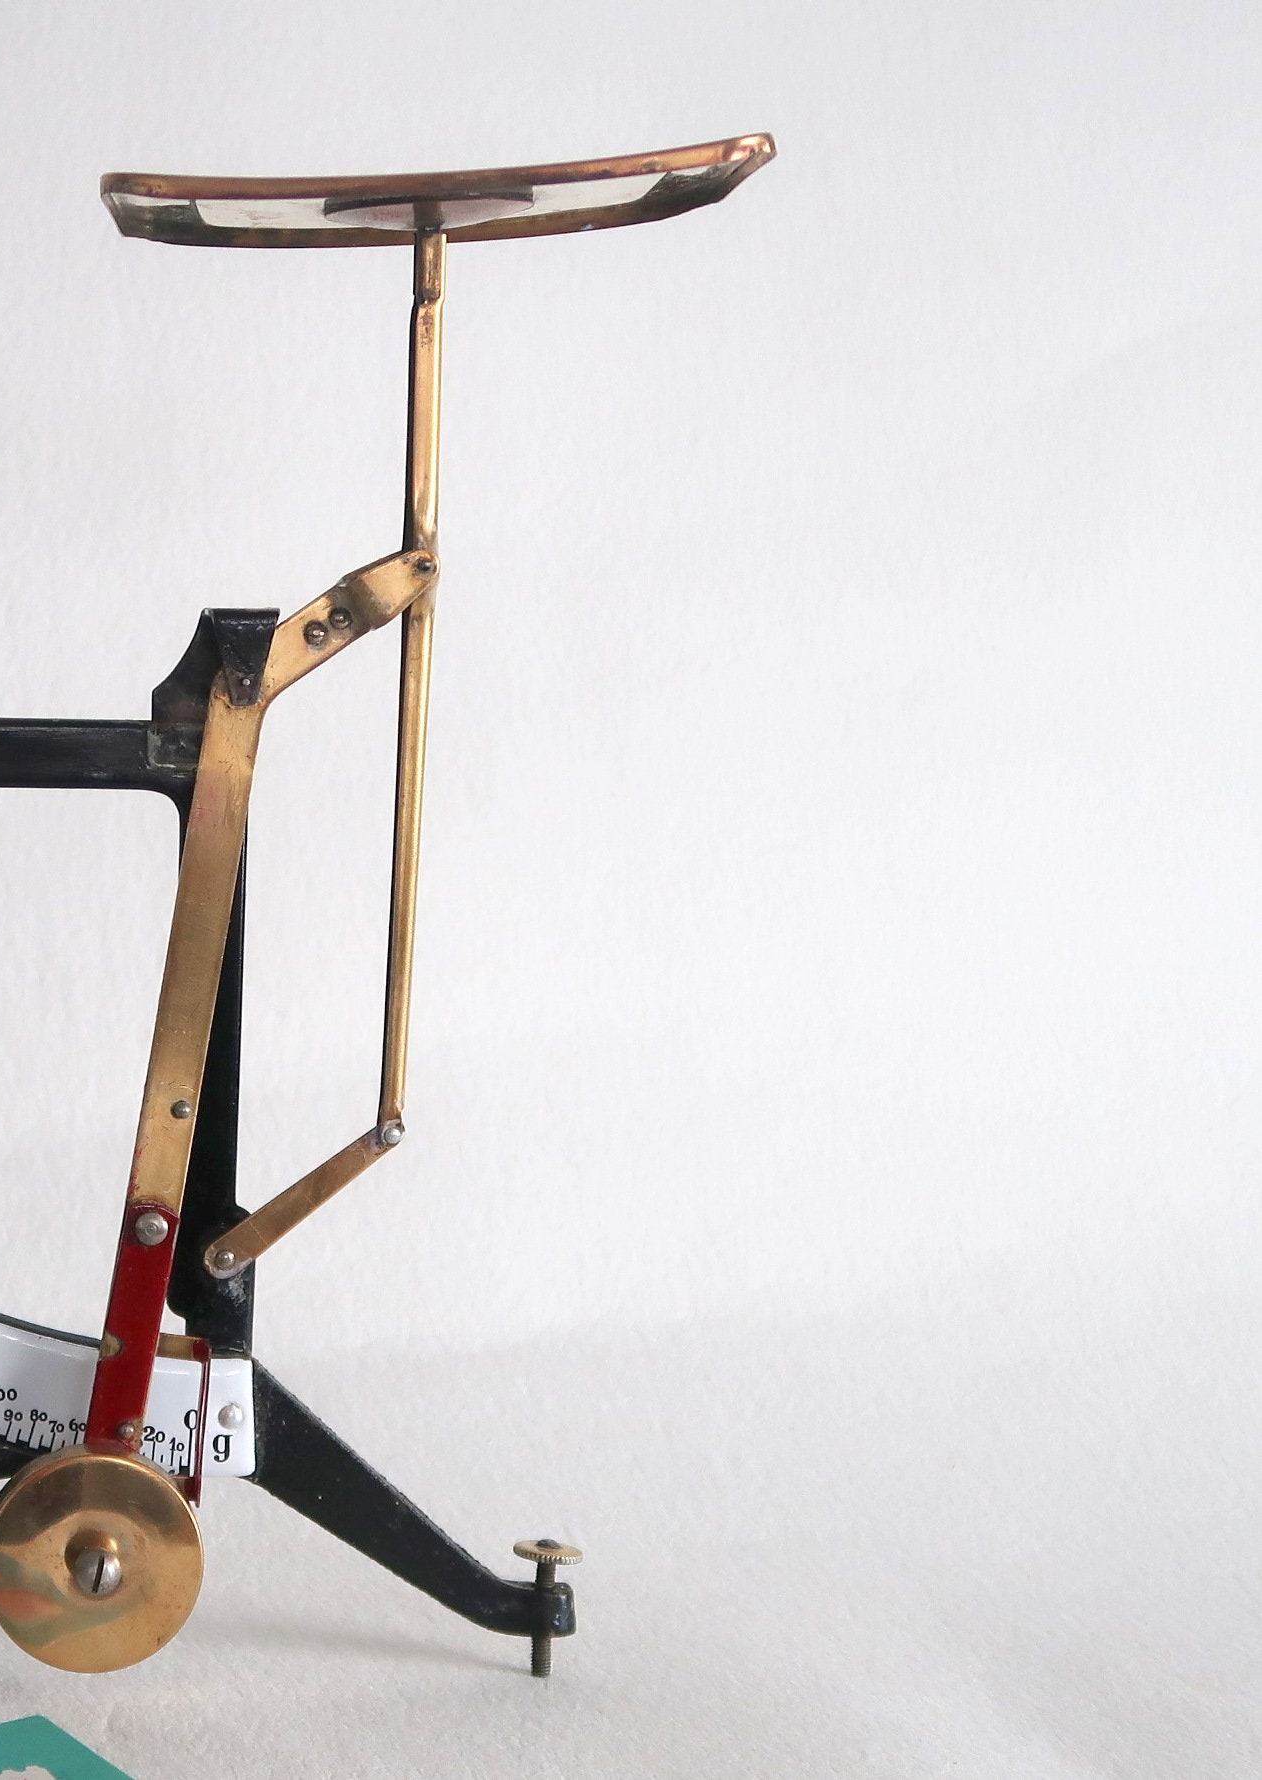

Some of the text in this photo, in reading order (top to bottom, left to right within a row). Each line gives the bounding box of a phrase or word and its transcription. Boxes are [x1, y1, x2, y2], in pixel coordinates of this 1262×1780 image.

[4, 1410, 23, 1421] 90
[30, 1410, 47, 1421] 80
[184, 1409, 198, 1430] 0
[49, 1421, 64, 1432] 70
[69, 1419, 87, 1431] 60
[144, 1426, 165, 1443] 20
[169, 1438, 184, 1451] 10
[213, 1434, 233, 1462] g
